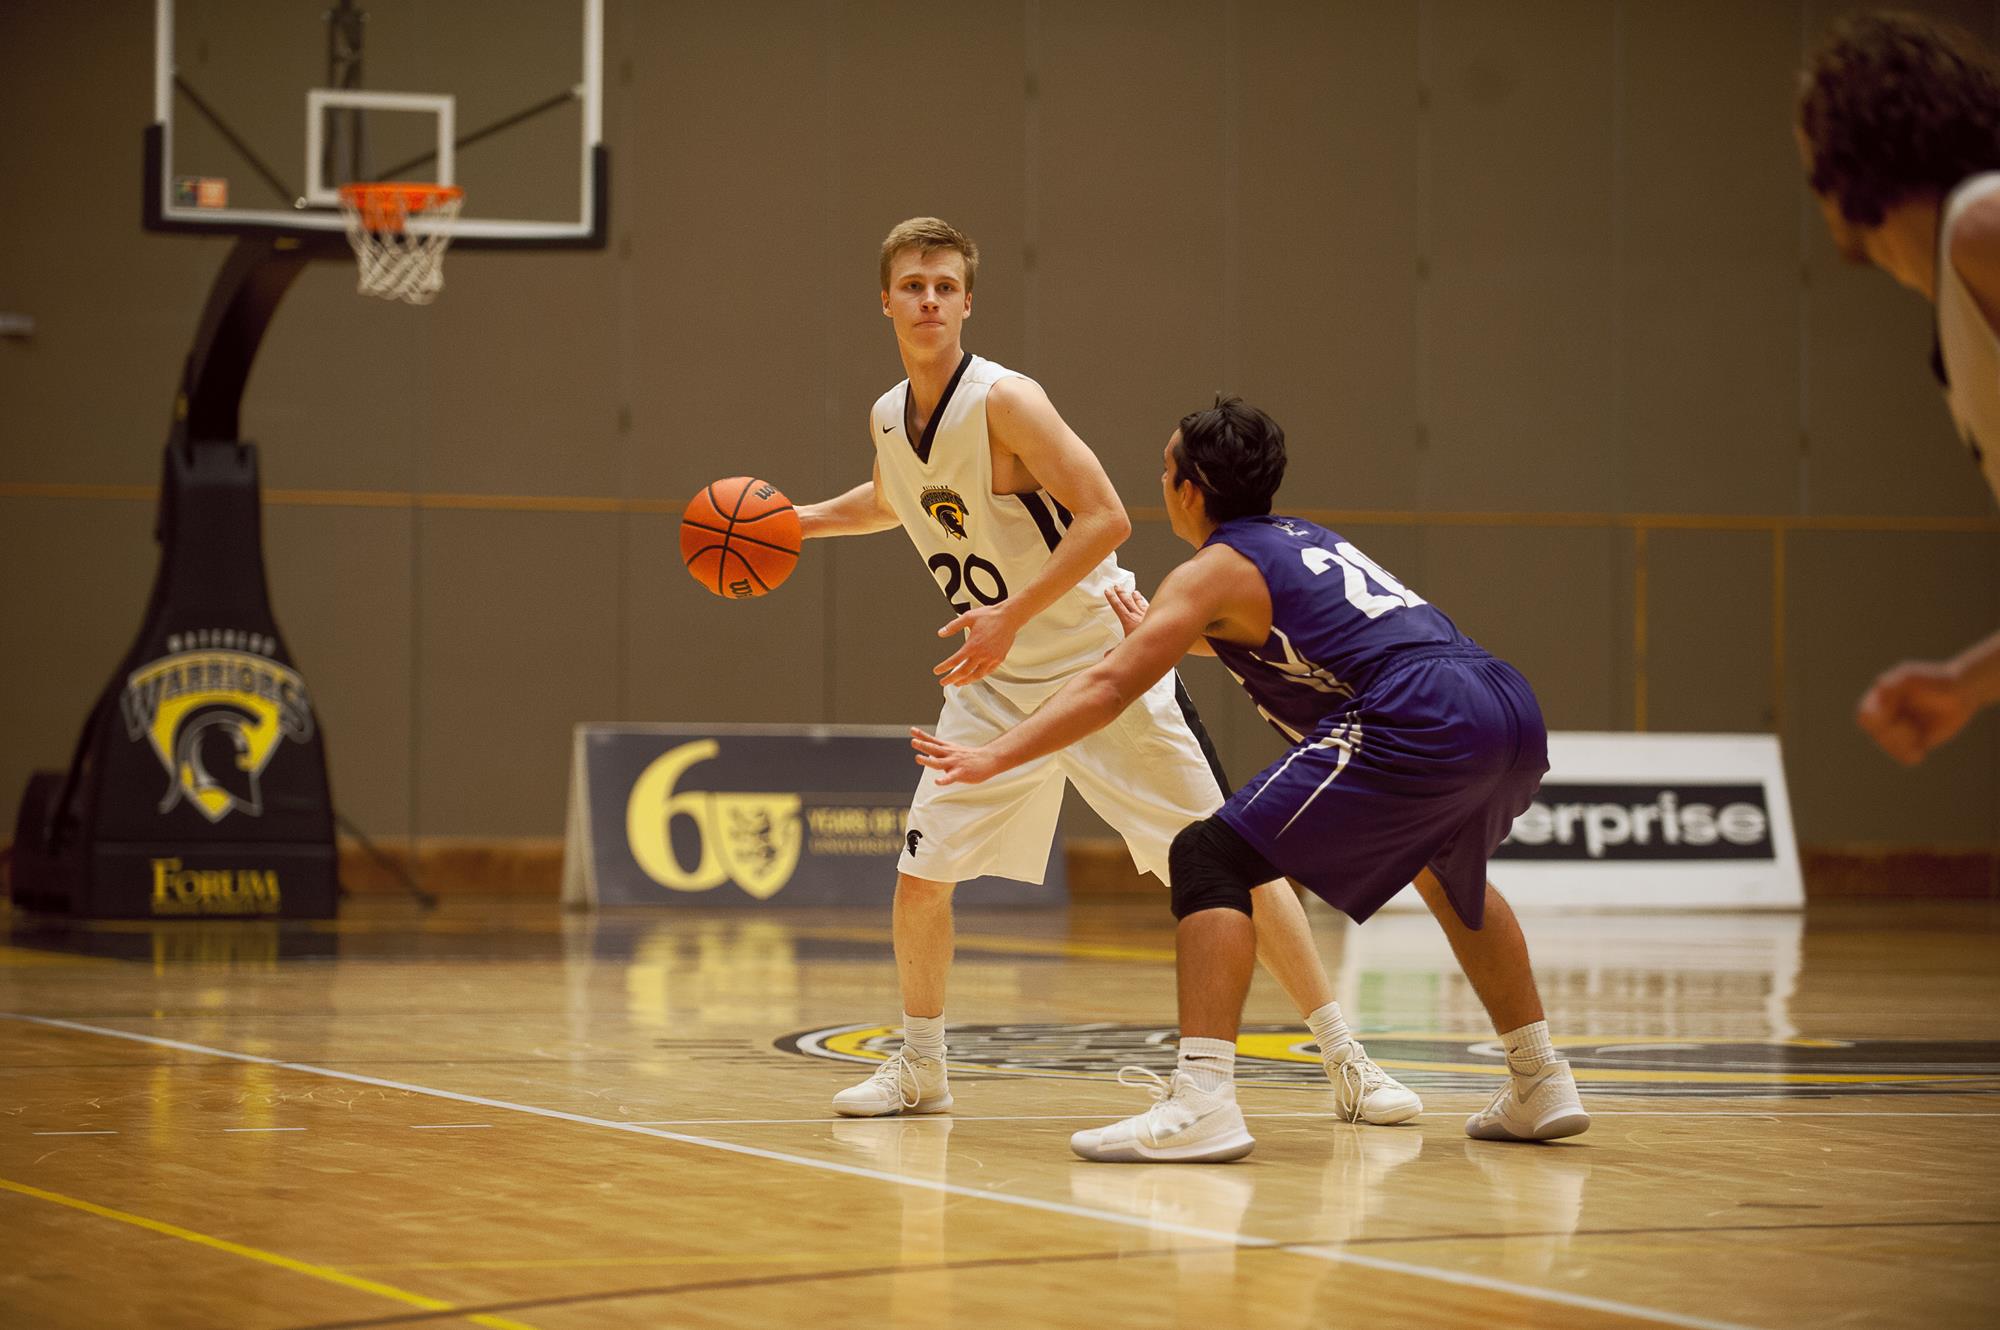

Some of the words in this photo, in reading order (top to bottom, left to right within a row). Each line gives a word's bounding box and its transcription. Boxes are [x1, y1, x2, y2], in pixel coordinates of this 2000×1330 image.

[927, 552, 1009, 615] 20
[120, 658, 314, 744] WARRIORS
[1508, 790, 1765, 857] erprise
